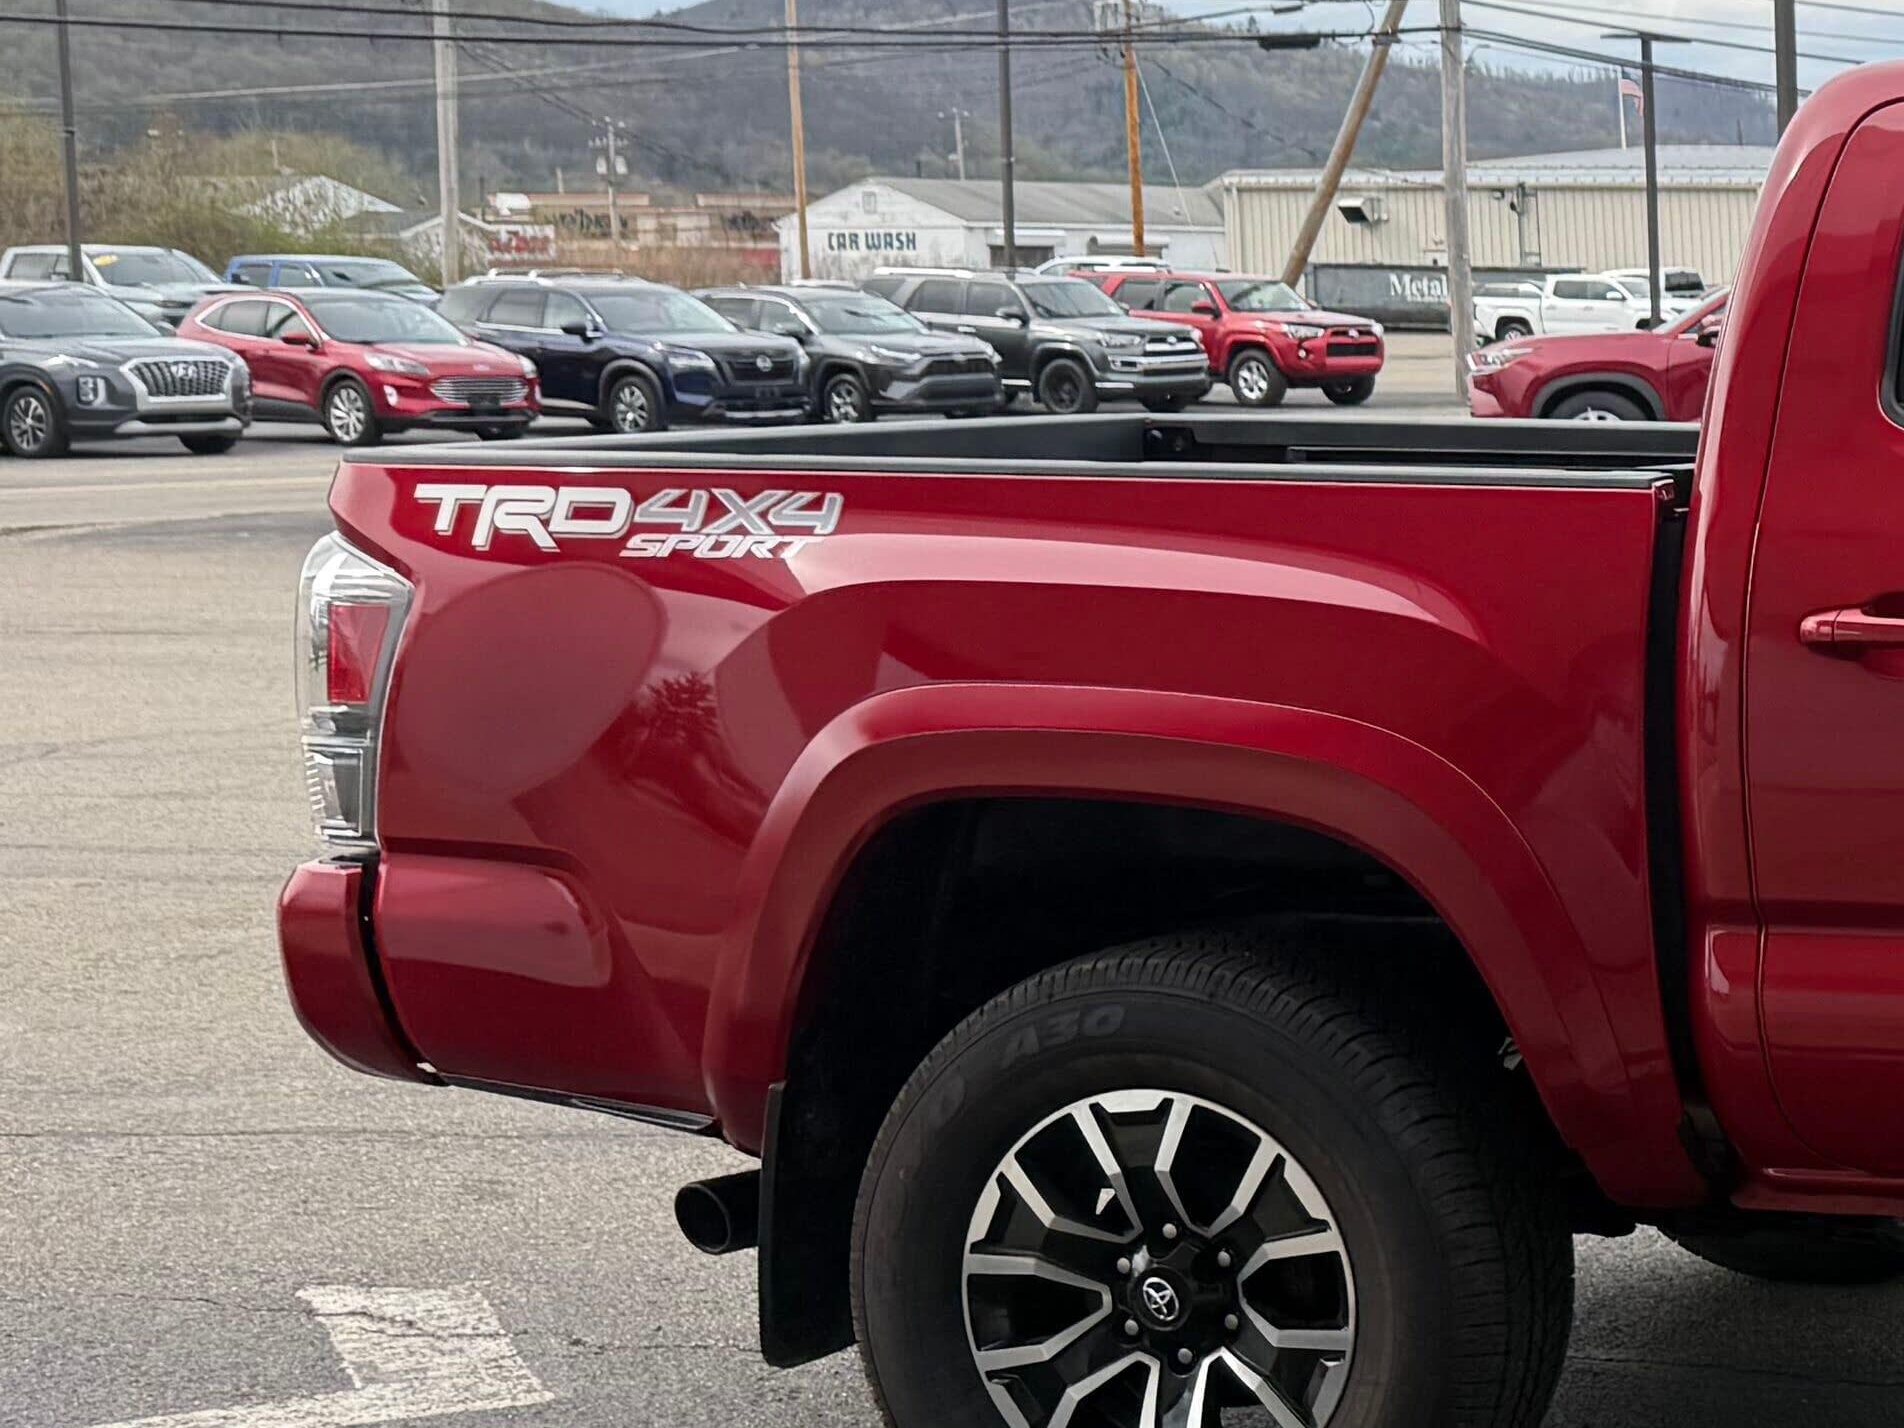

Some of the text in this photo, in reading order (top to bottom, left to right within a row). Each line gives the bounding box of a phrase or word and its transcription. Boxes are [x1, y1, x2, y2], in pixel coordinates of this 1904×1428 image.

[827, 231, 917, 251] CAR WASH
[1388, 273, 1449, 299] Metal
[413, 483, 635, 553] TRD
[618, 534, 826, 560] SPORT
